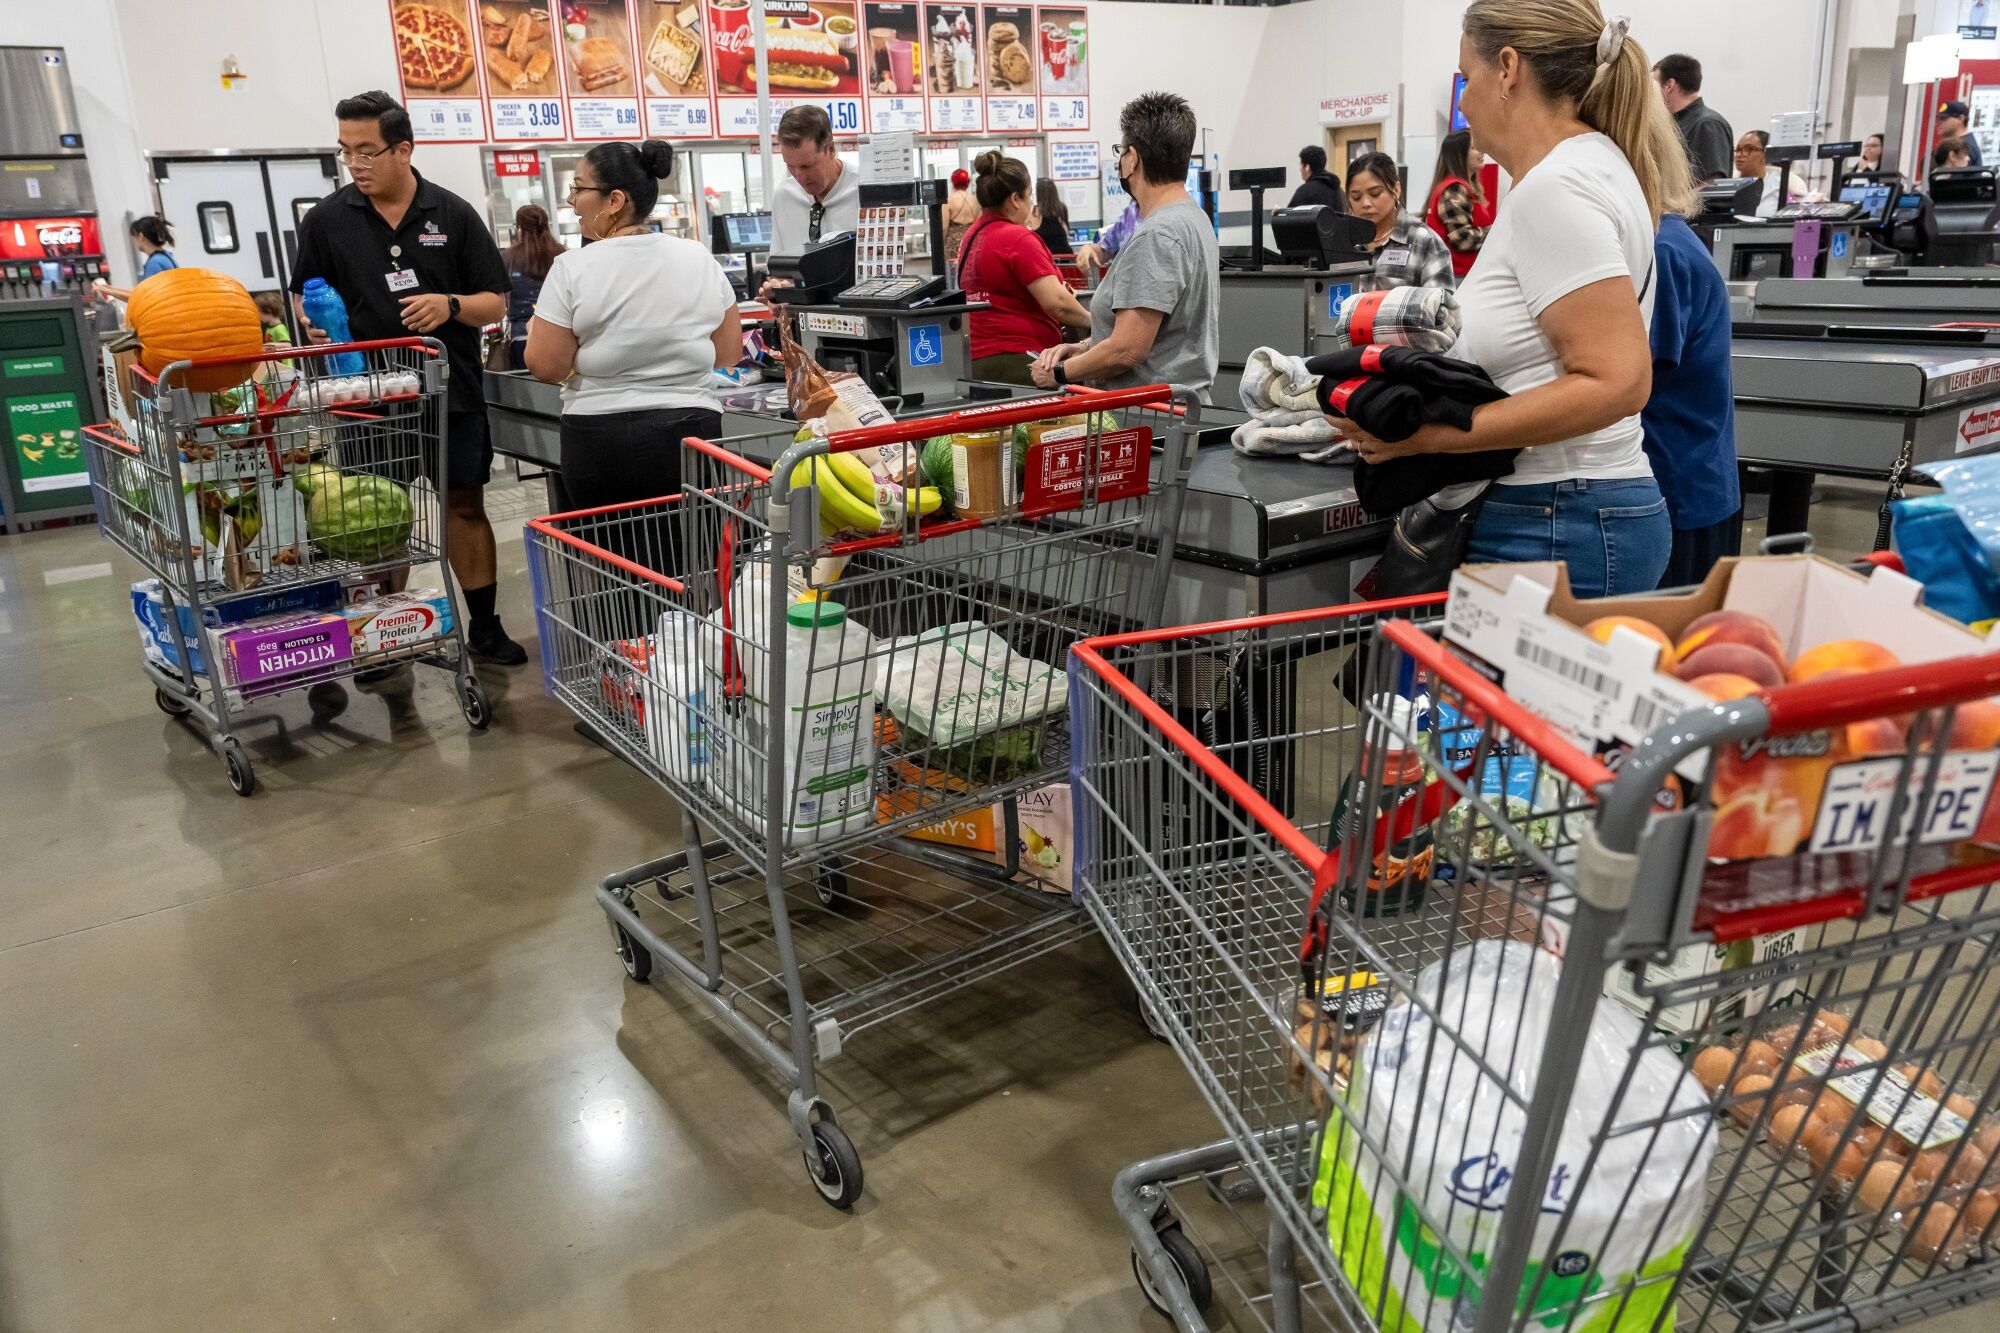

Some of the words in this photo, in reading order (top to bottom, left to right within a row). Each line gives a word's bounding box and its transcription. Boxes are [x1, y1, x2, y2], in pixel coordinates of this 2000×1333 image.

[1320, 94, 1389, 110] MERCHANDISE
[528, 102, 560, 126] 3.99
[616, 109, 637, 124] 6.99
[687, 109, 707, 124] 6.99
[1335, 106, 1373, 119] PICK-UP
[39, 226, 82, 245] Coca-Cola
[394, 278, 413, 287] KEVIN
[32, 361, 54, 369] WASTE
[1951, 372, 1970, 390] LEAVE
[1970, 367, 1990, 387] HEAVY
[10, 403, 39, 413] FOOD
[40, 400, 73, 411] WASTE
[960, 405, 1001, 416] COSTCO
[223, 450, 265, 462] TRAI
[1053, 480, 1082, 491] COSTCO
[1326, 504, 1364, 531] LEAVE
[376, 612, 420, 630] Premier
[316, 634, 325, 642] 13
[380, 625, 418, 641] Protein
[256, 642, 278, 651] Bags
[284, 636, 315, 649] GALLON
[259, 643, 336, 674] KITCHEN
[815, 705, 858, 724] Simply
[812, 719, 858, 738] Purrfec
